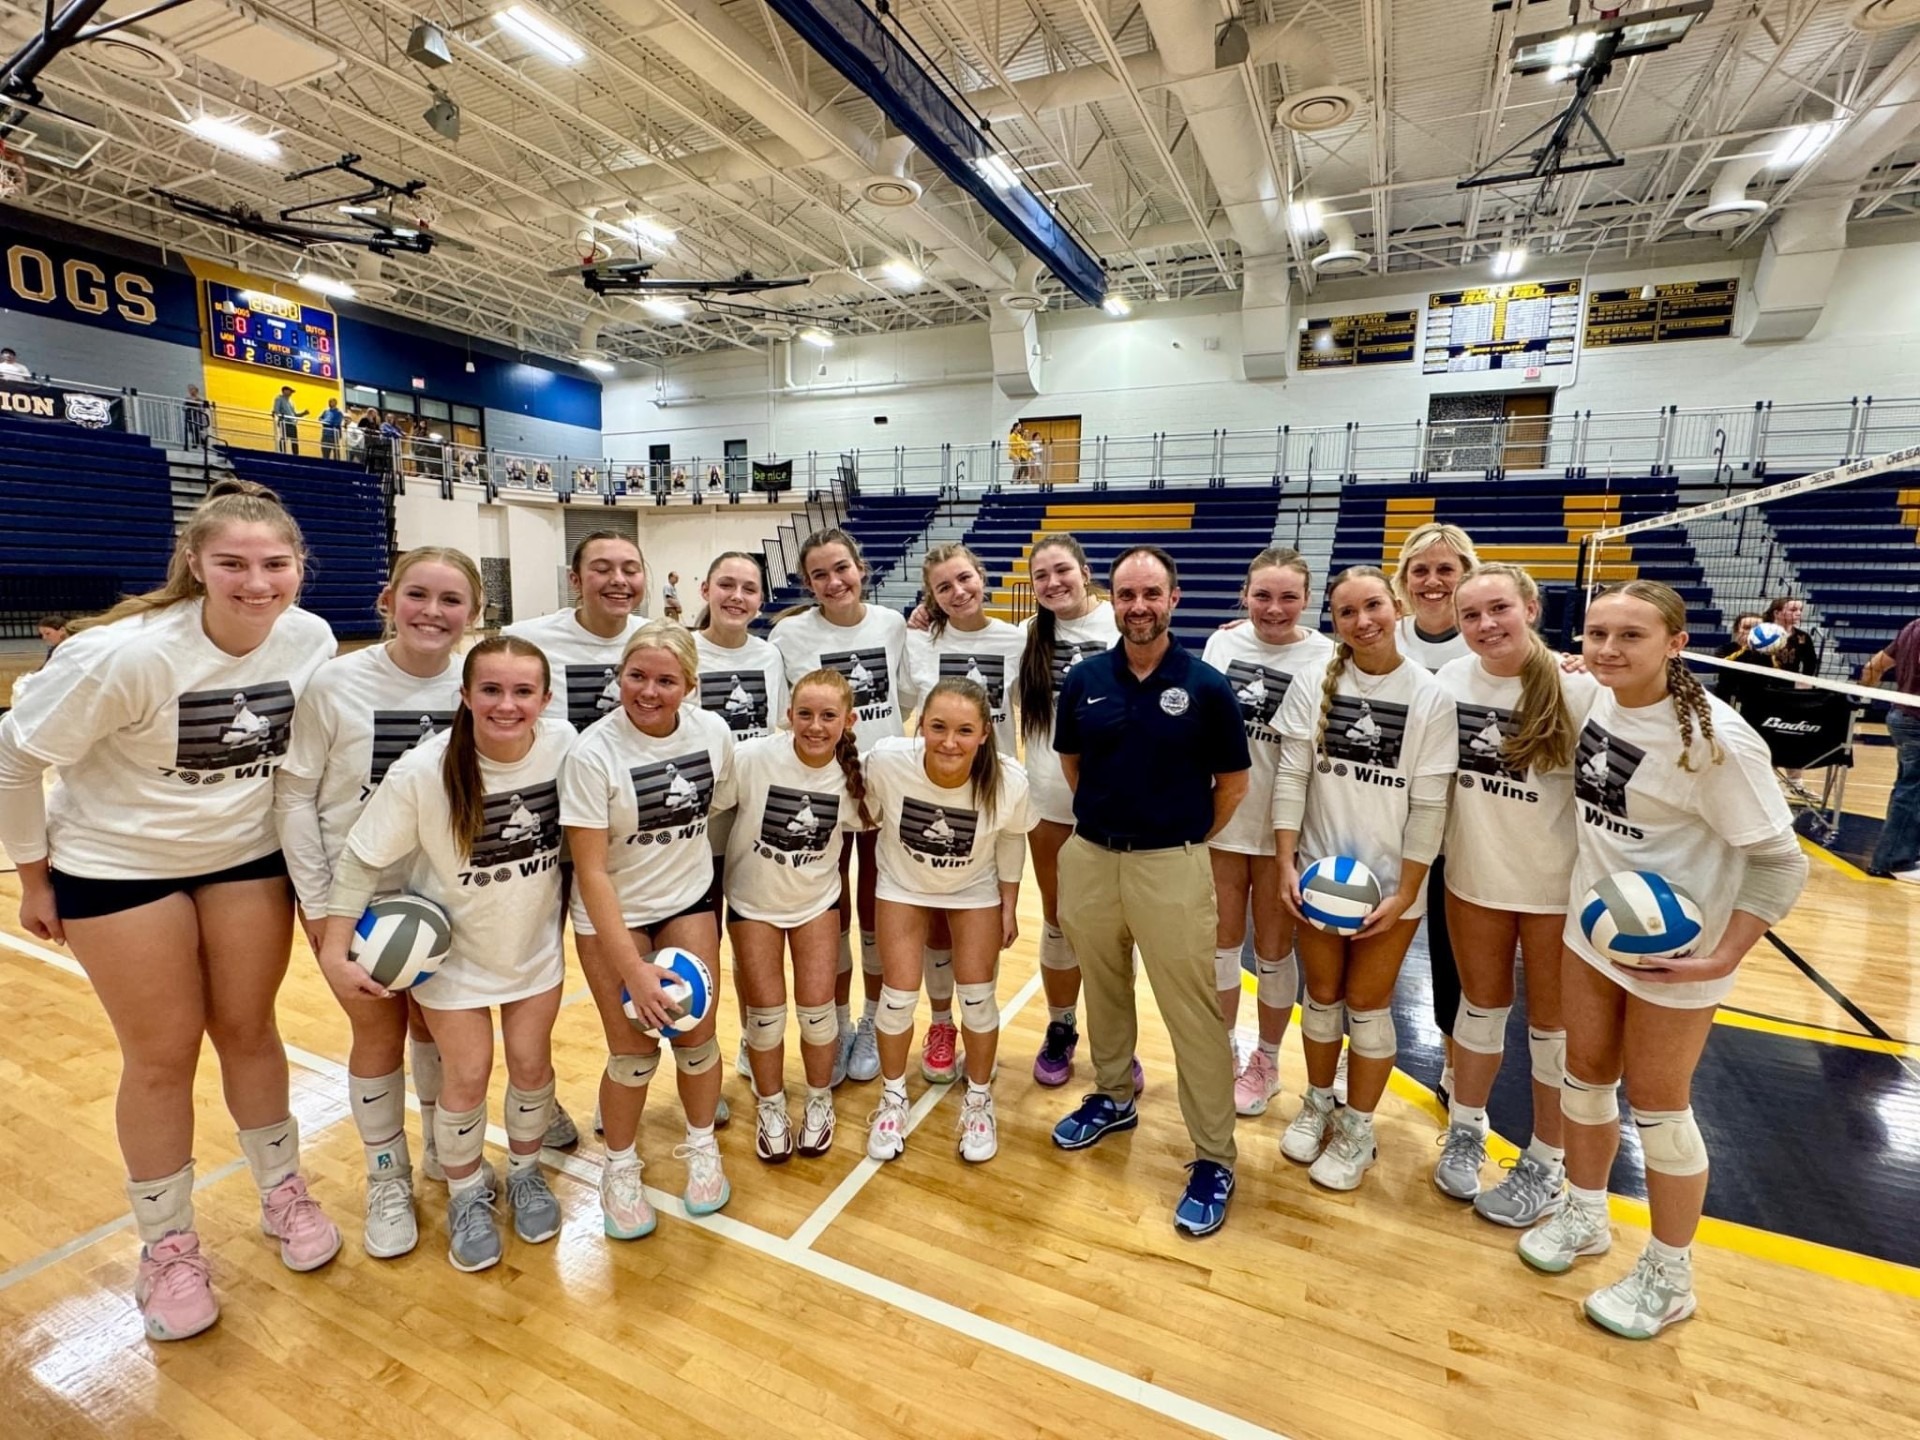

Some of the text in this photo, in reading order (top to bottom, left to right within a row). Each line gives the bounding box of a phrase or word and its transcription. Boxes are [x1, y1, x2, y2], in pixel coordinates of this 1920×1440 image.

[7, 245, 157, 325] OGS
[245, 346, 255, 361] 2
[0, 391, 55, 417] ION
[1886, 446, 1920, 465] CHELSEA
[754, 470, 787, 480] be nice
[991, 713, 1006, 724] ns
[1761, 717, 1822, 733] Baden
[235, 761, 279, 779] Wi
[1354, 766, 1407, 789] Wins
[1481, 777, 1540, 803] Wins
[1585, 806, 1644, 840] Wins
